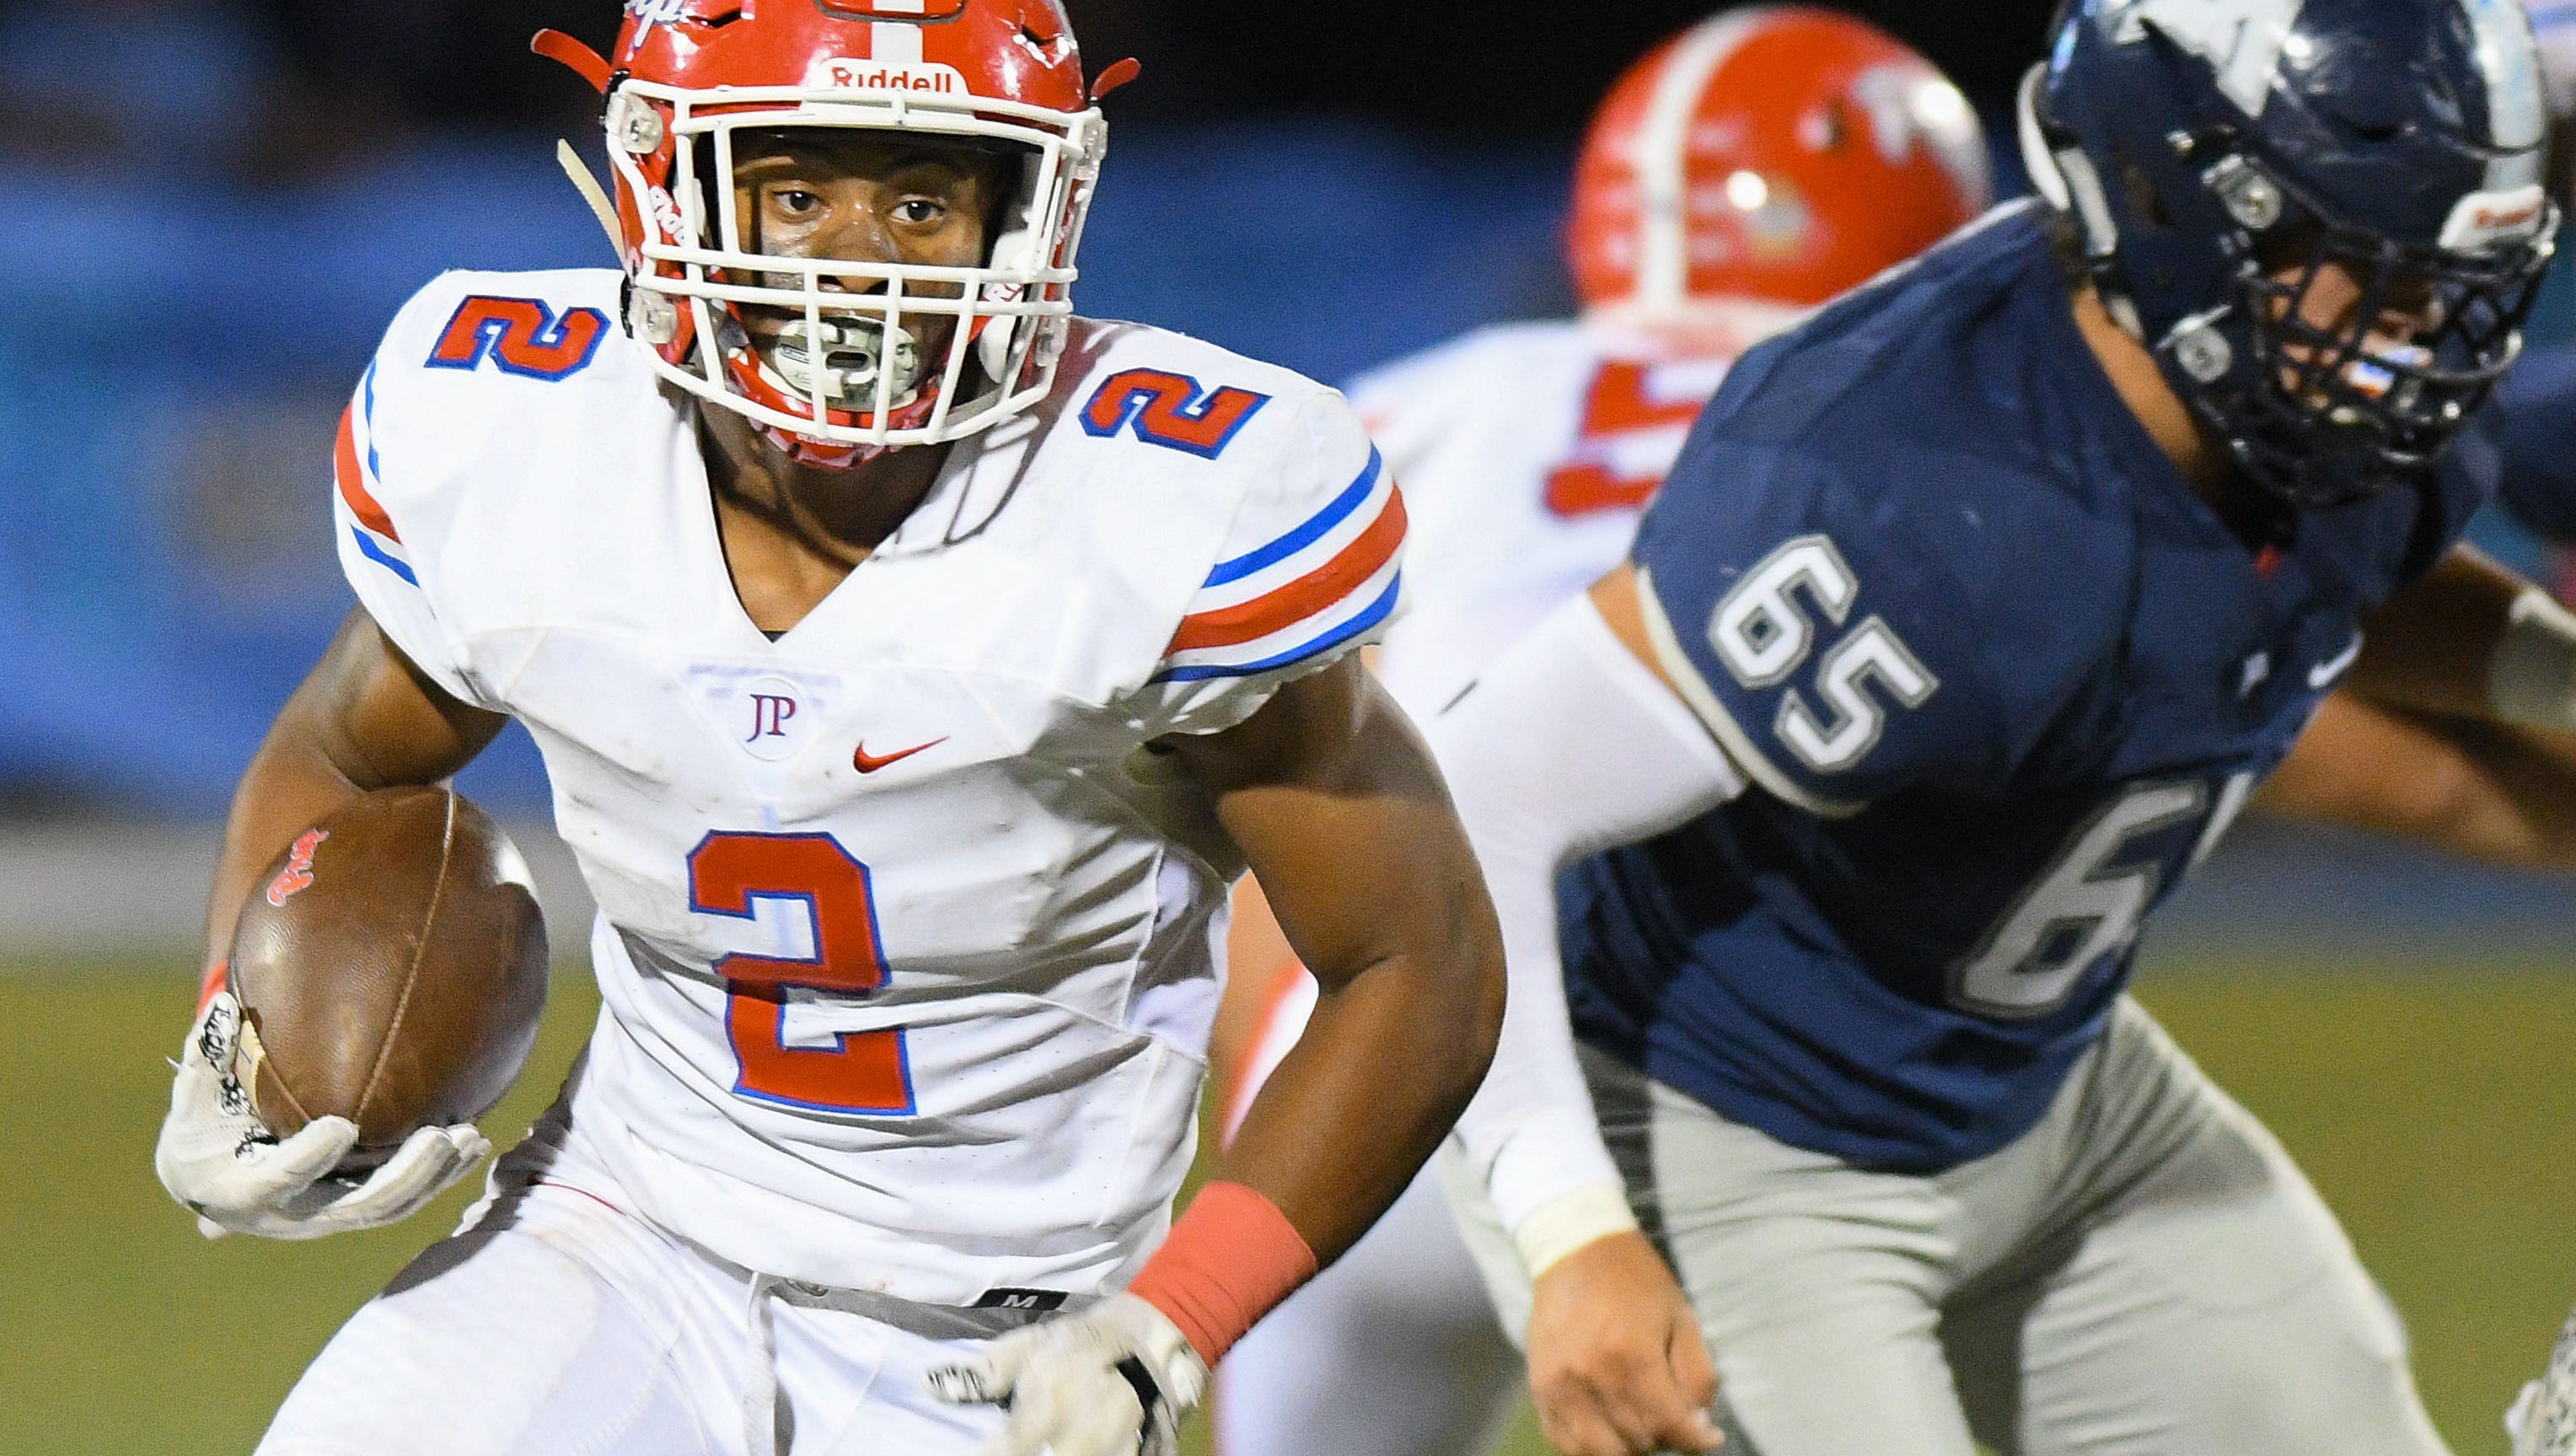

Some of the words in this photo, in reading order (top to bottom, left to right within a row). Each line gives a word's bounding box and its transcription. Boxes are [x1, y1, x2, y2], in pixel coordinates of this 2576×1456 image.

[831, 67, 952, 94] Riddell
[423, 293, 612, 384] 2
[1078, 368, 1274, 461] 2
[1708, 533, 1940, 776] 65
[746, 693, 797, 743] JP
[1945, 769, 2257, 1018] 6
[686, 829, 917, 1117] 2
[1001, 1293, 1039, 1309] M
